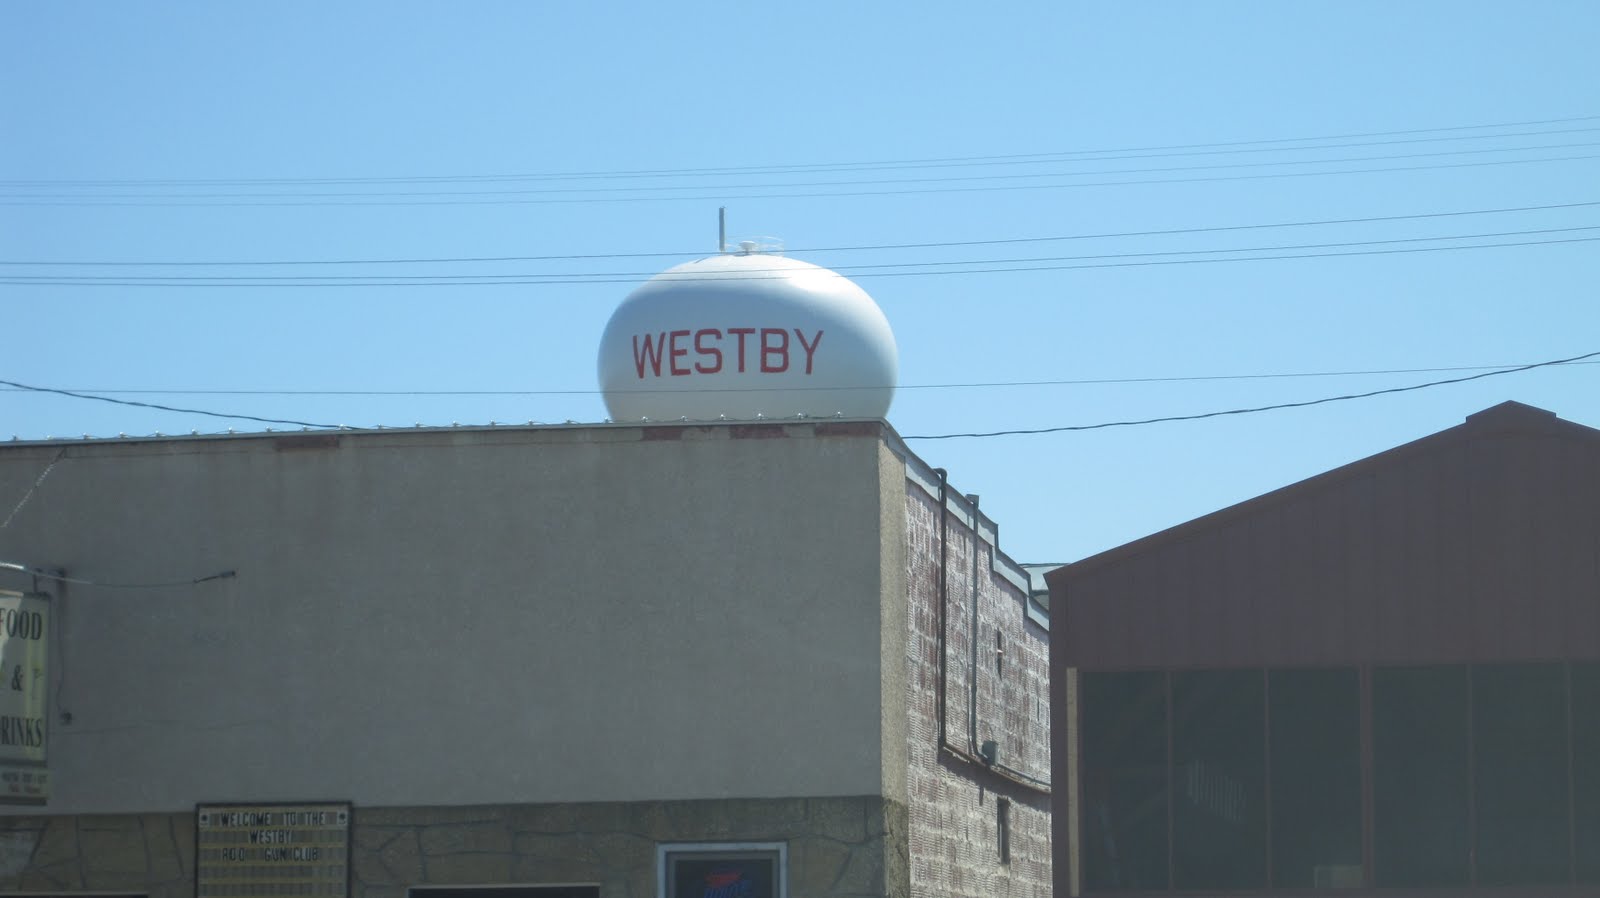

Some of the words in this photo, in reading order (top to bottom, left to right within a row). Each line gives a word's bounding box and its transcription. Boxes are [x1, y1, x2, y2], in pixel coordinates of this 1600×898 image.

[633, 328, 824, 379] WESTBY
[11, 664, 23, 691] &
[0, 716, 42, 747] RINKS
[220, 812, 271, 826] WELCOME
[285, 812, 297, 826] TO
[306, 811, 325, 826] THE
[250, 830, 292, 844] WESTBY
[264, 847, 287, 861] GUN
[293, 847, 319, 861] CLUB
